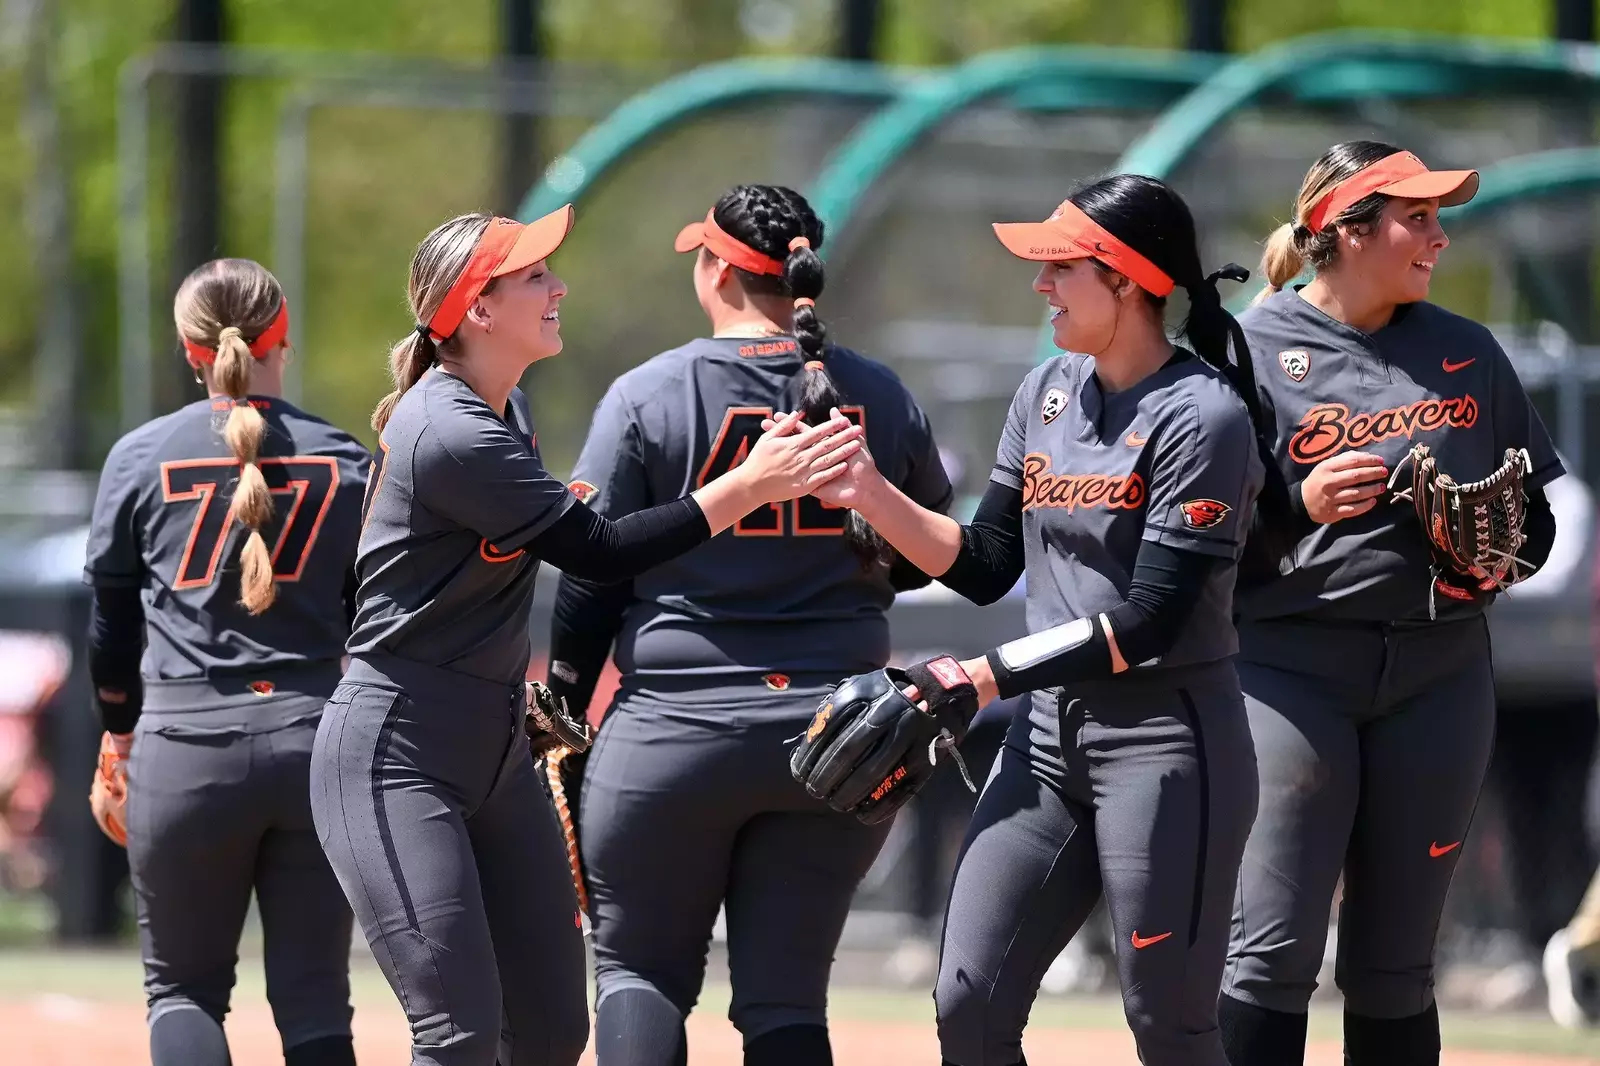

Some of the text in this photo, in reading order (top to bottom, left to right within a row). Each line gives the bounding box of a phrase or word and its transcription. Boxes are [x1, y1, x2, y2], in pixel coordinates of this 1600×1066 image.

[1029, 246, 1074, 255] SOFTBALL
[1288, 394, 1479, 465] Beavers
[1022, 452, 1145, 516] Beavers
[161, 456, 340, 591] 77
